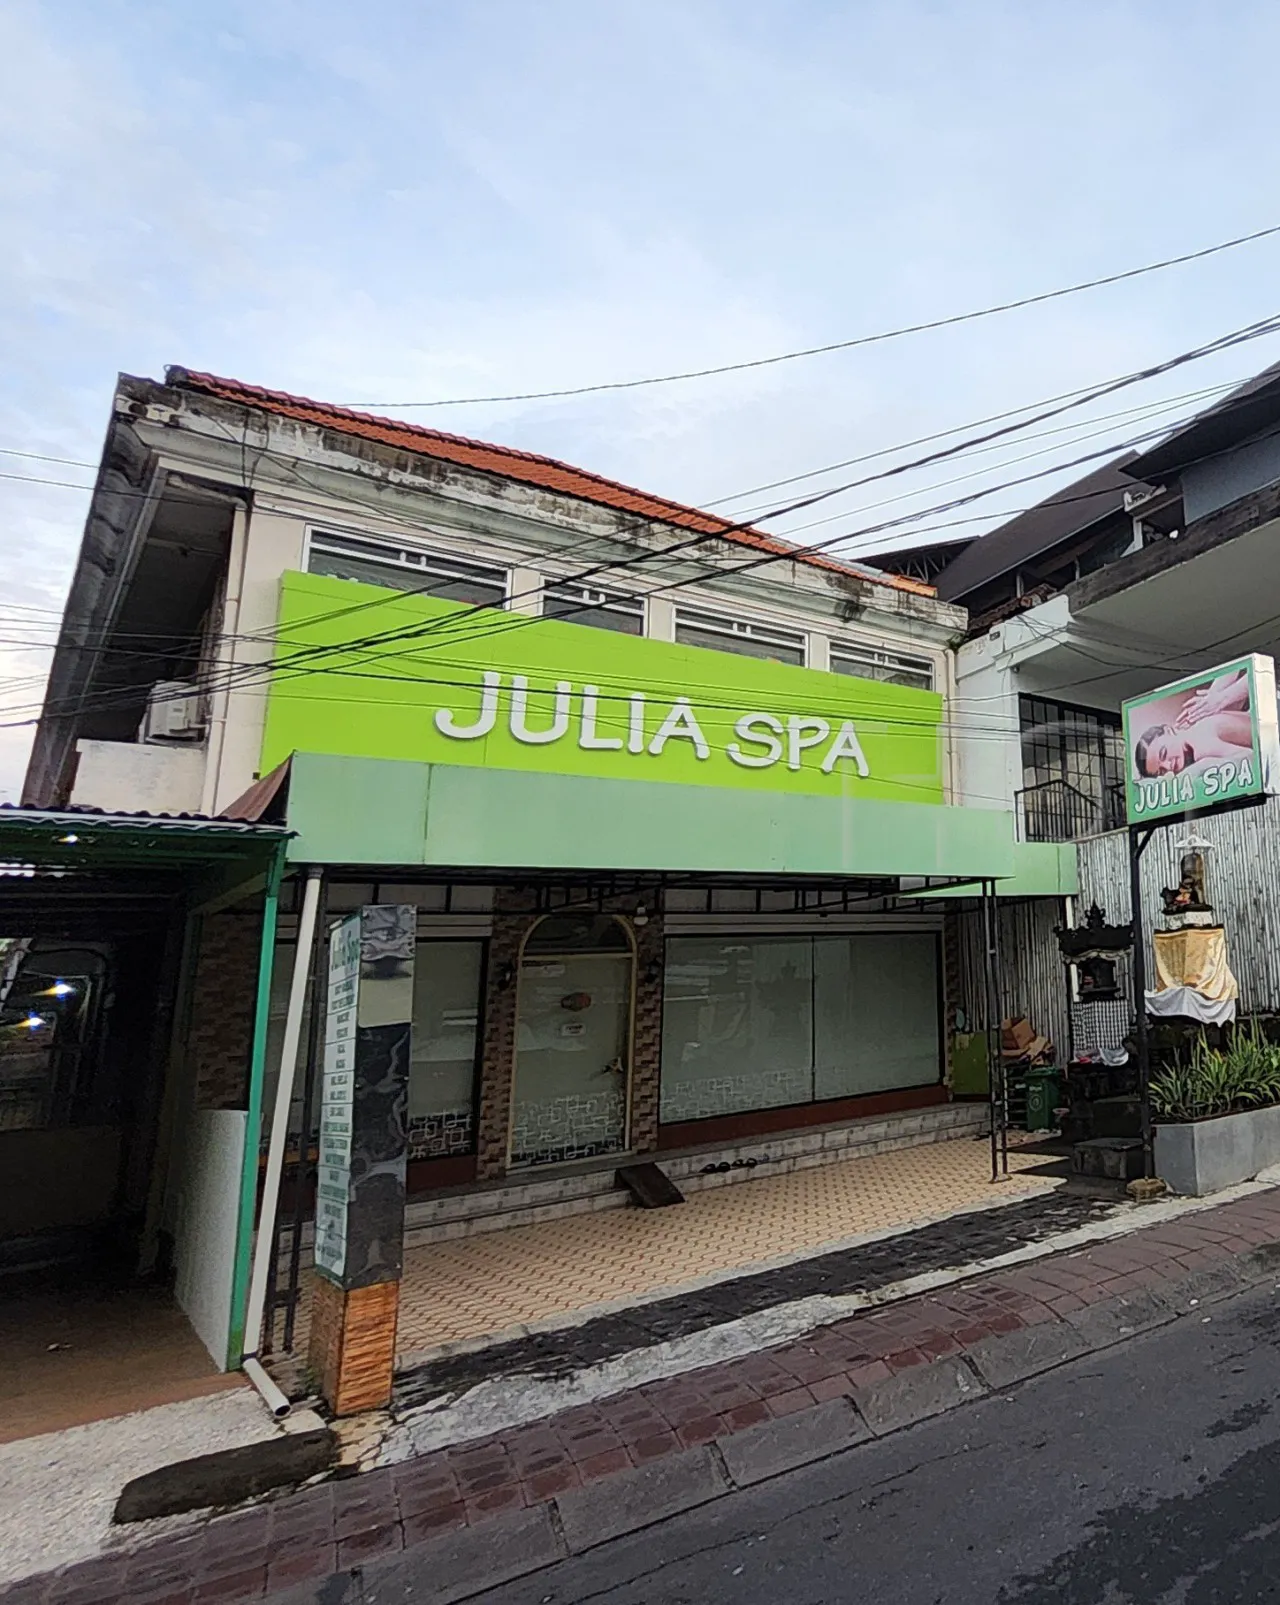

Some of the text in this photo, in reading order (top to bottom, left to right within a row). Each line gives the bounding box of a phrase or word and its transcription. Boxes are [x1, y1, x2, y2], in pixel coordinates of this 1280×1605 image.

[433, 671, 871, 778] JULIA SPA
[1133, 758, 1254, 814] JULIA SPA
